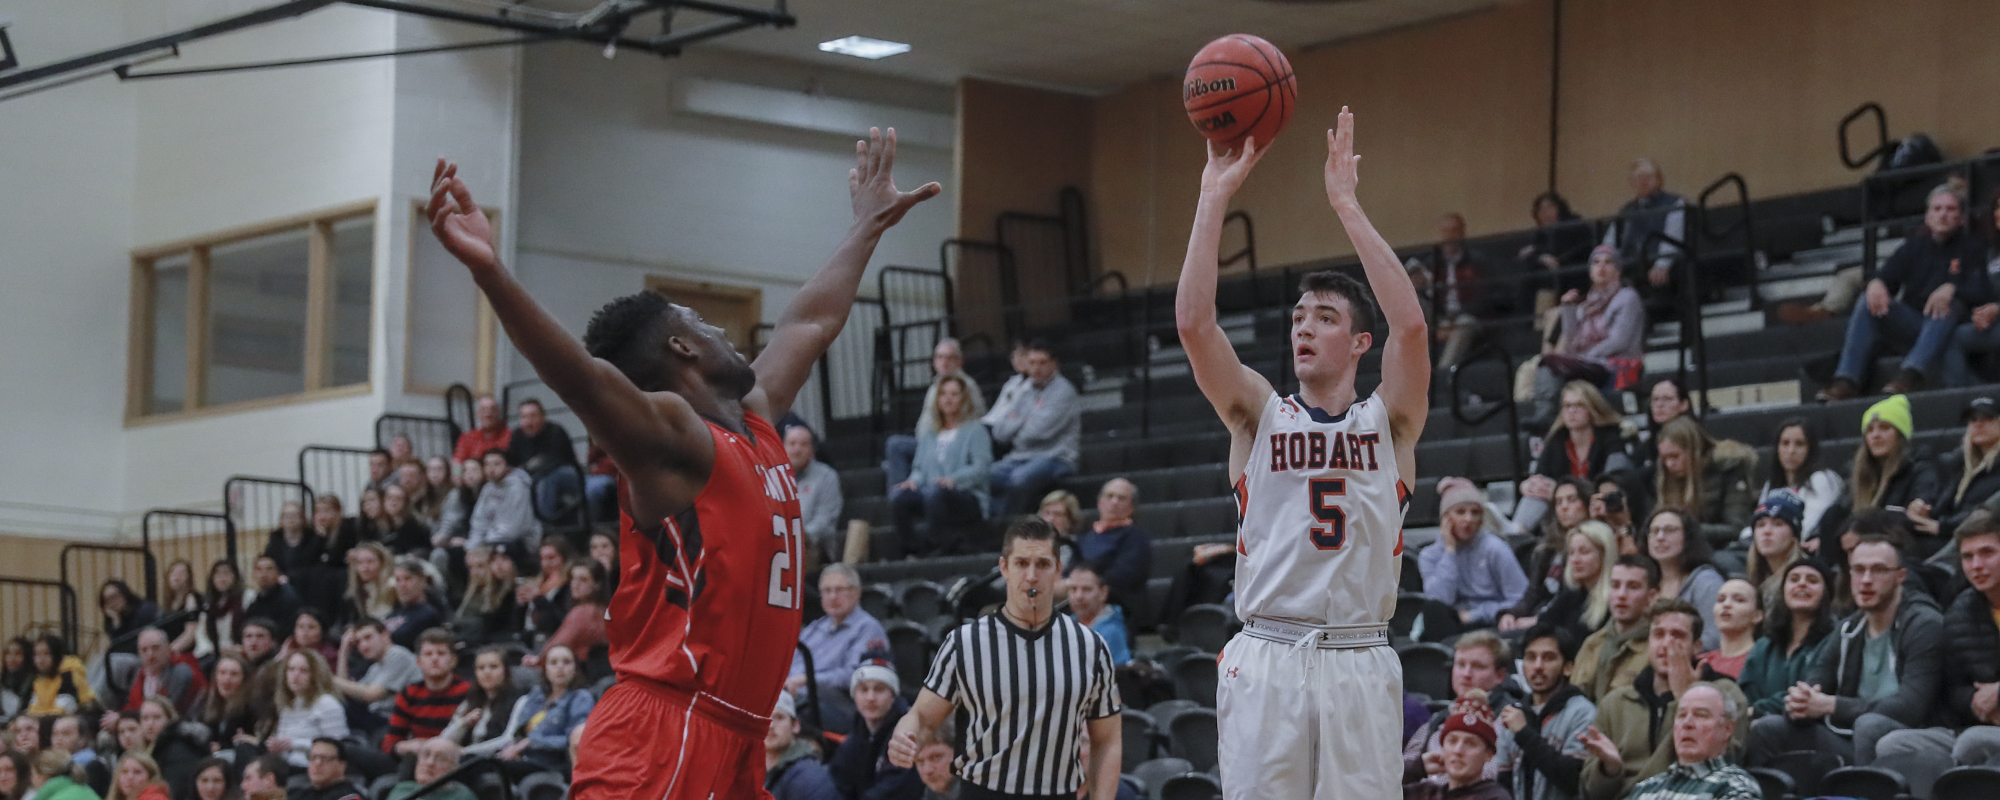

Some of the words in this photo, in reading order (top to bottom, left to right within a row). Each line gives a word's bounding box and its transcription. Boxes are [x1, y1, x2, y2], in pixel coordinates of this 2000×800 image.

[1270, 431, 1380, 472] HOBART
[1308, 478, 1346, 550] 5
[767, 512, 801, 611] 21
